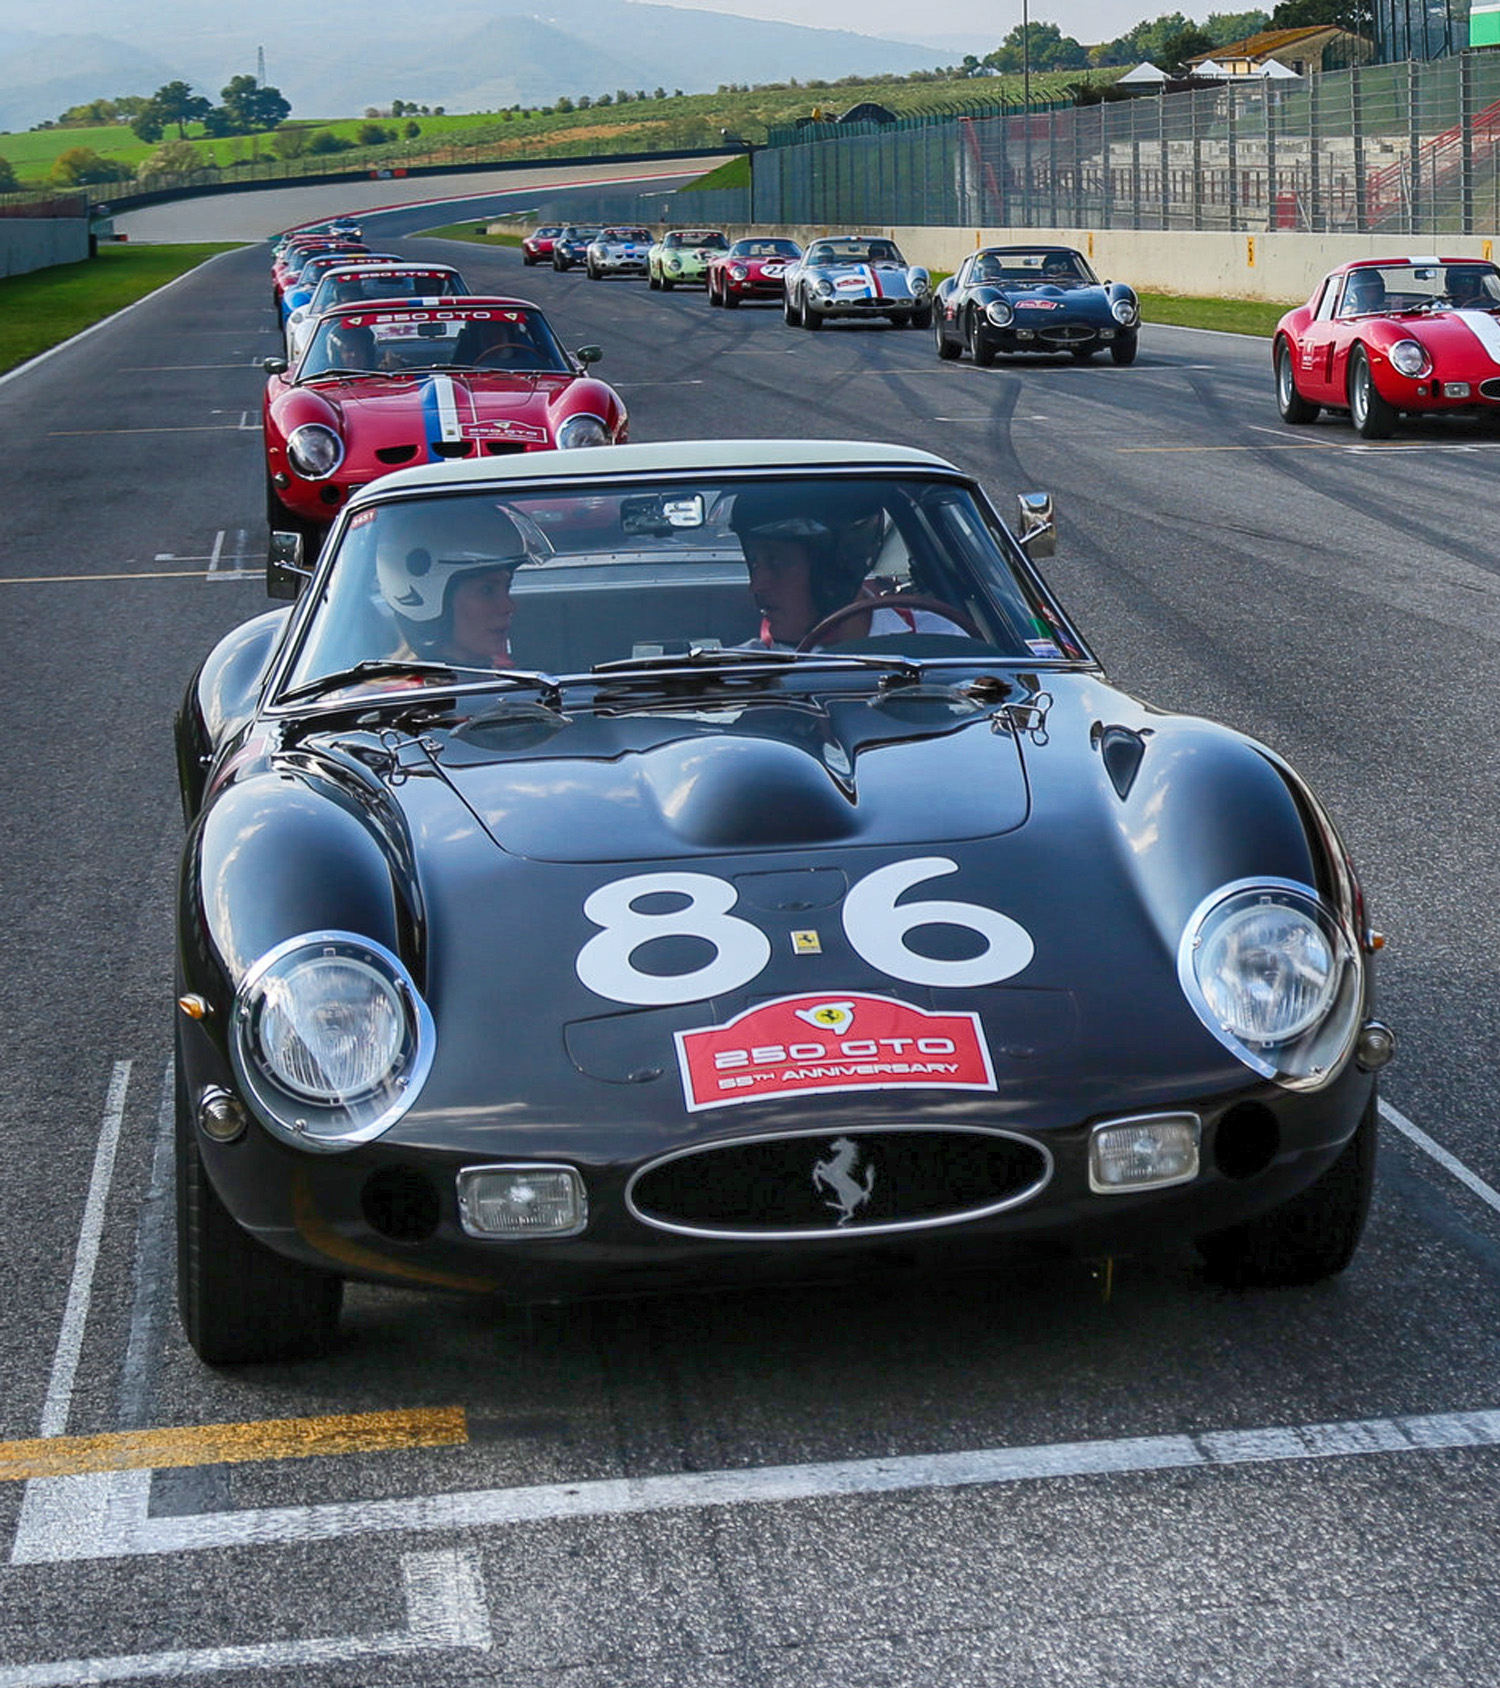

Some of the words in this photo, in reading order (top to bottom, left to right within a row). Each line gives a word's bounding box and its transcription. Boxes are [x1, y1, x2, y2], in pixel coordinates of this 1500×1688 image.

[375, 312, 430, 323] 250
[436, 311, 491, 319] GTO
[714, 1043, 826, 1070] 250
[839, 1037, 957, 1057] GTO
[718, 1073, 775, 1090] 55TH
[781, 1063, 960, 1082] ANNIVERSARY
